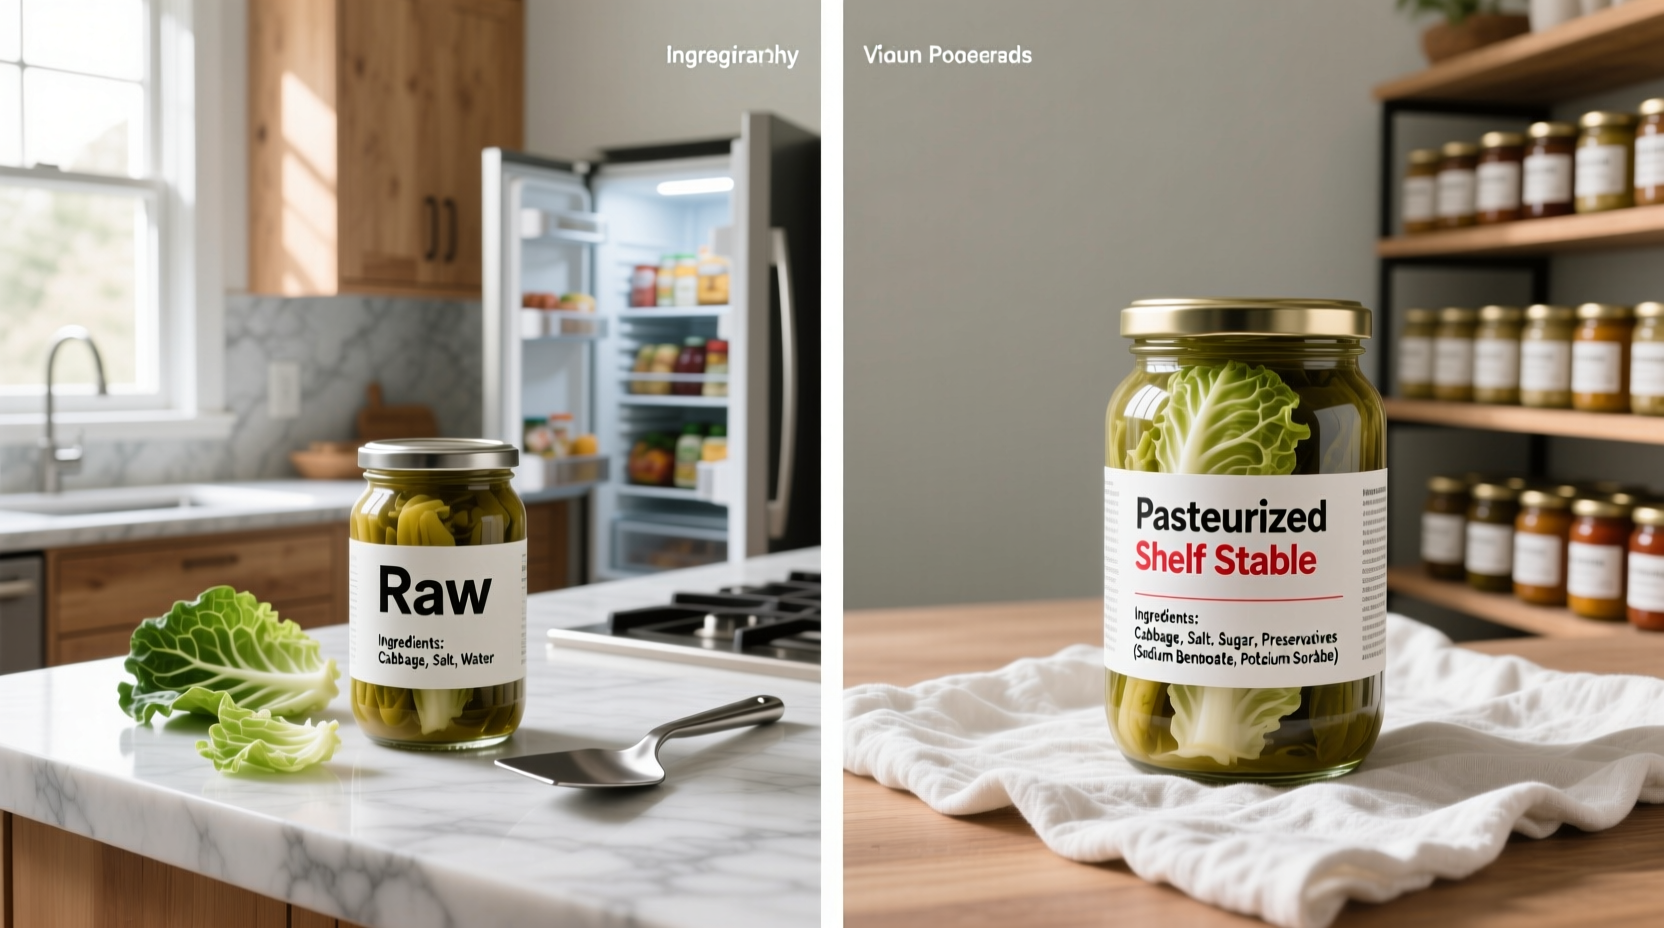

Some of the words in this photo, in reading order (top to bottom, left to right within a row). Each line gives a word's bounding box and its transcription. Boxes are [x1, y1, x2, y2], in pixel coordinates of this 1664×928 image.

[1136, 496, 1327, 533] Pasteurized
[1135, 539, 1207, 574] Shelf
[1214, 543, 1317, 576] Stable
[379, 564, 493, 616] Raw
[378, 633, 445, 650] Ingredients:
[1218, 632, 1258, 650] Sugar,
[378, 650, 429, 670] Cabbage,
[432, 653, 458, 669] Salt,
[460, 652, 495, 666] Water
